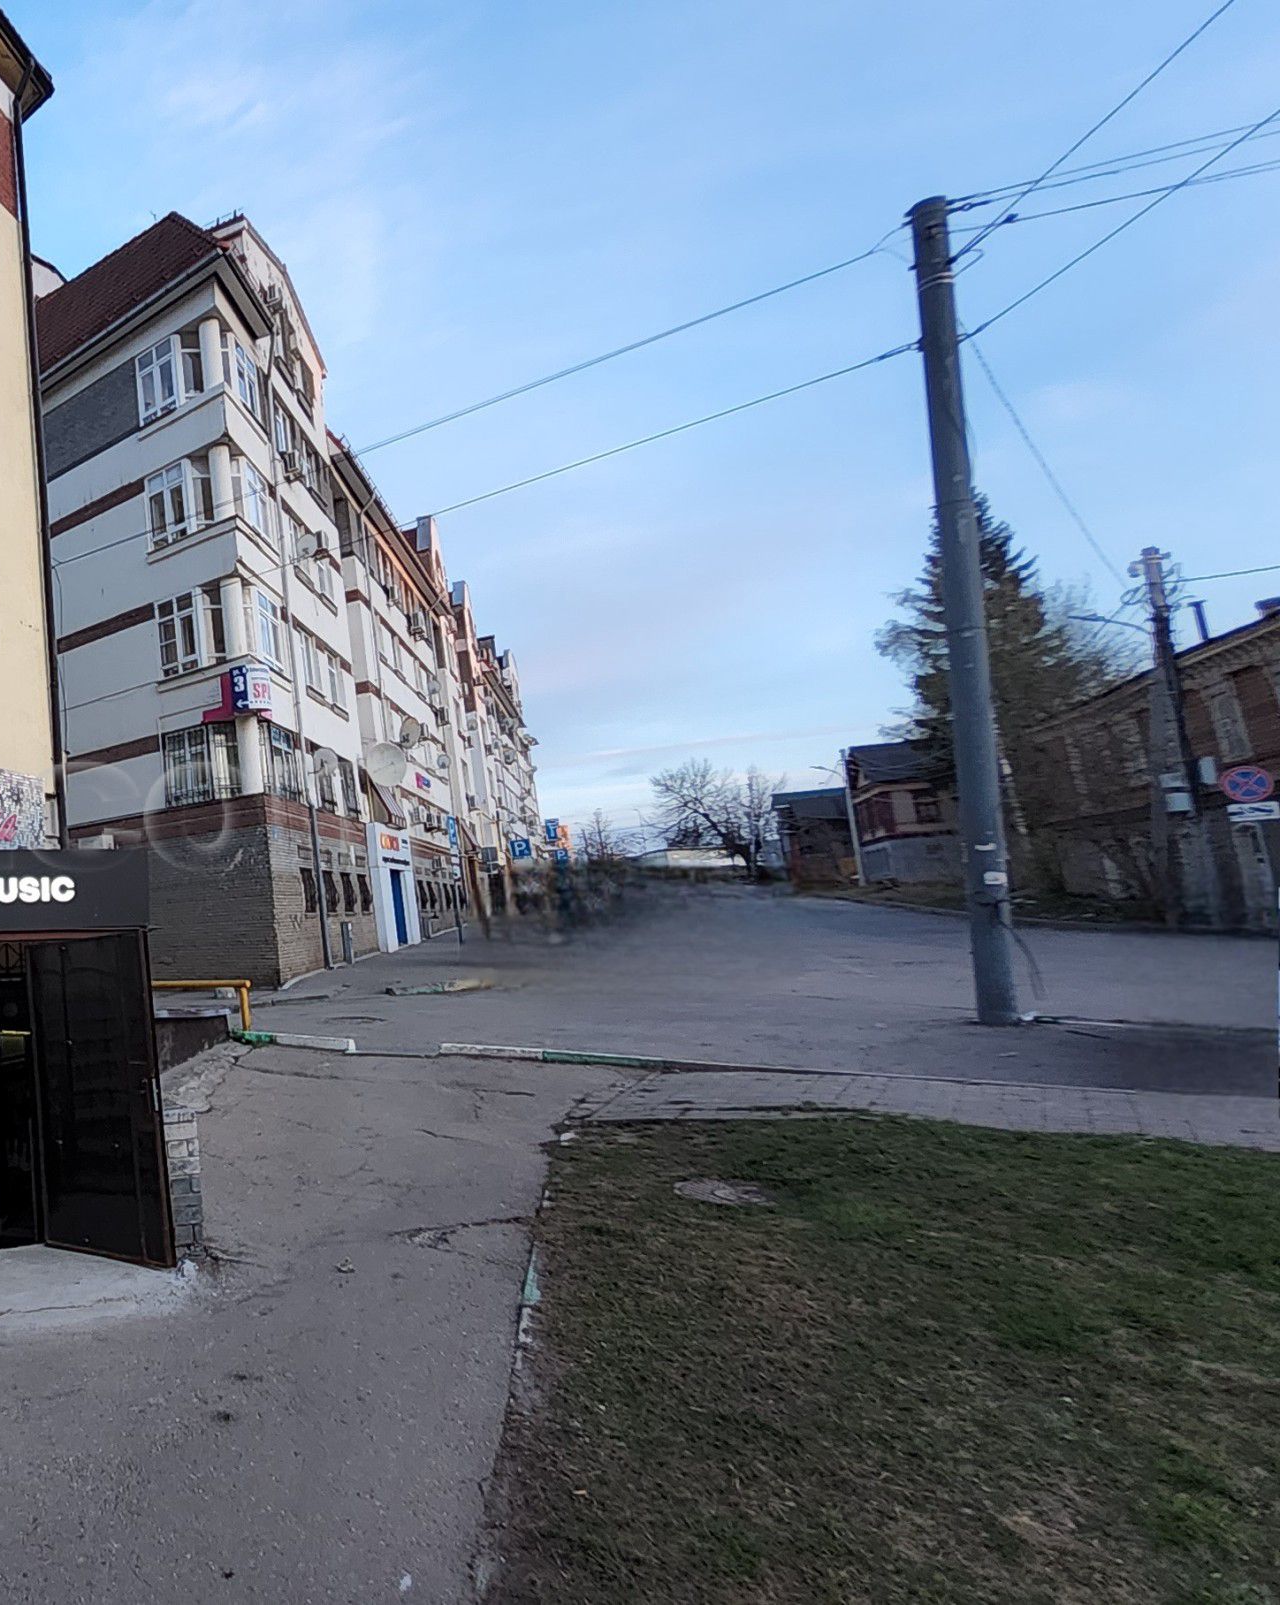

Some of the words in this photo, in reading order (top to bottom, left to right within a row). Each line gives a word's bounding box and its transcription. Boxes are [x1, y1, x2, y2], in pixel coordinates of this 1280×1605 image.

[233, 675, 245, 693] 3
[514, 841, 527, 856] P
[557, 850, 565, 860] P
